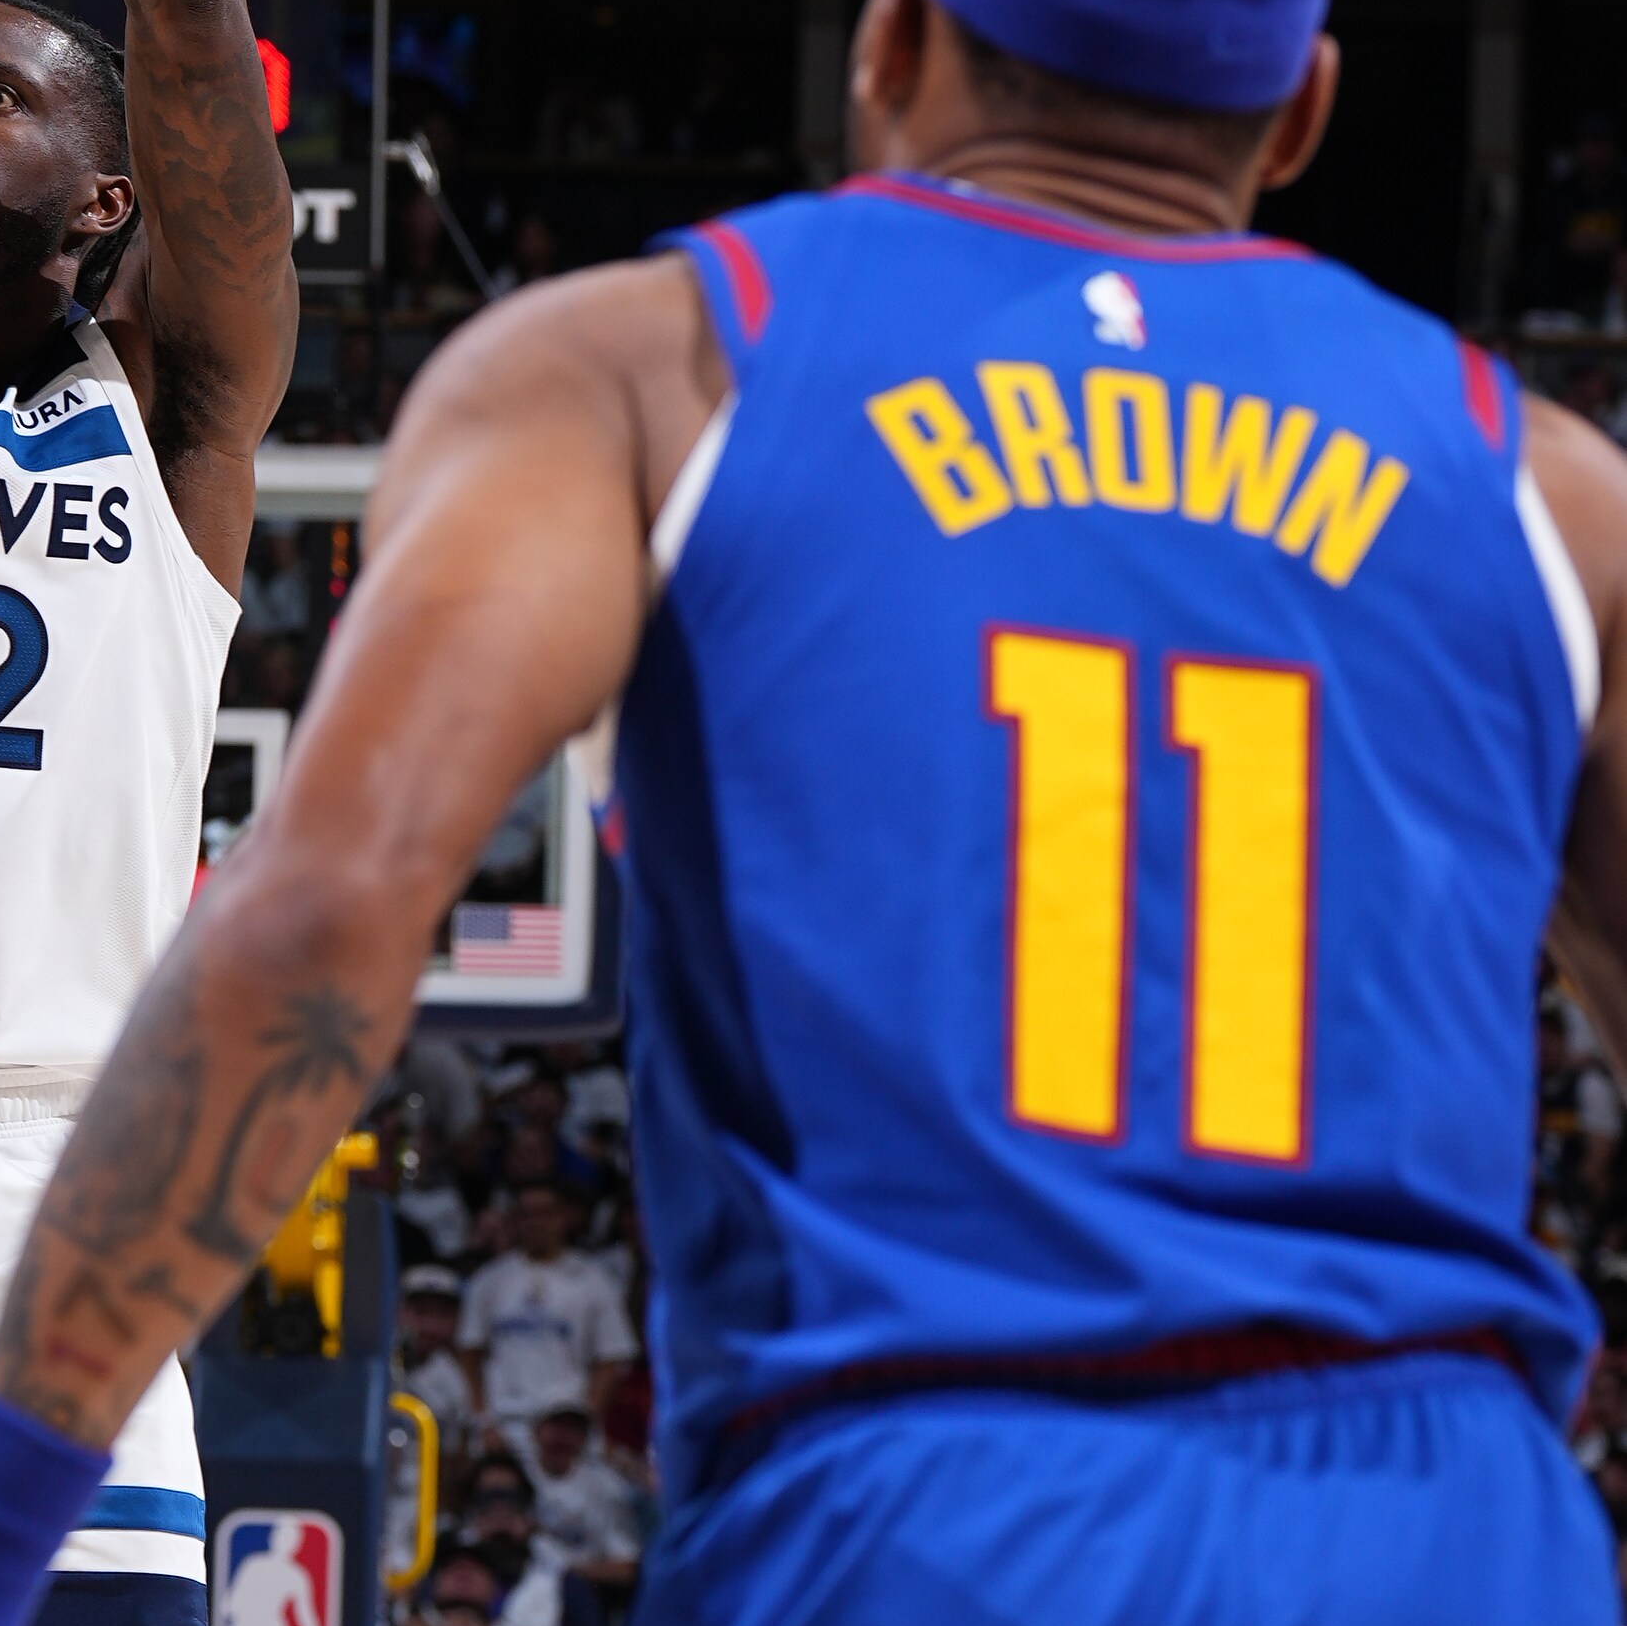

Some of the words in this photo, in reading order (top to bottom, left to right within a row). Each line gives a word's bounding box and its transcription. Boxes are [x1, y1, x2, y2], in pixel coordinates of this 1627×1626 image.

[15, 389, 84, 430] URA
[865, 360, 1410, 589] BROWN
[984, 620, 1321, 1172] 11
